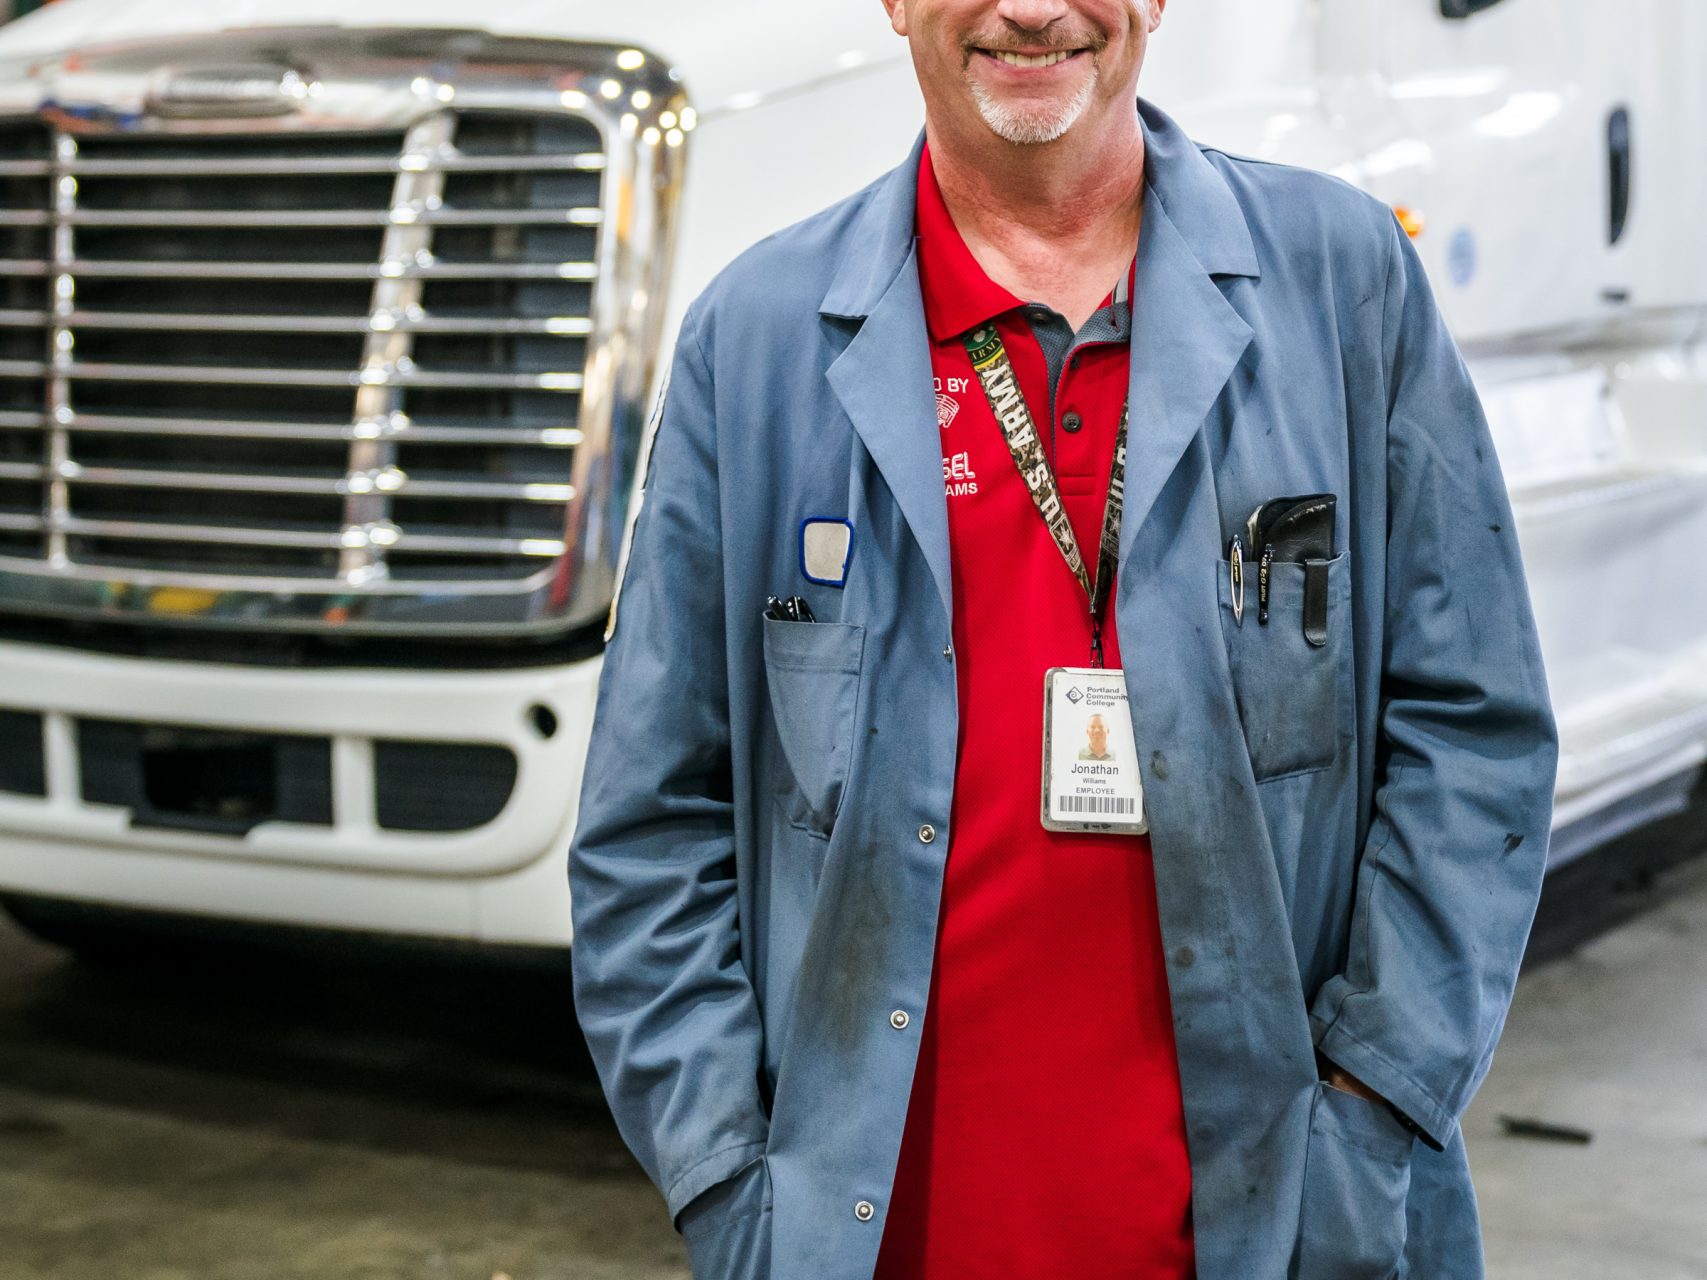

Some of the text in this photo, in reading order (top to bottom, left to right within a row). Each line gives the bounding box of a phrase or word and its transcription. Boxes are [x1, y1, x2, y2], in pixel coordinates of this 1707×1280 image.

[947, 377, 969, 393] BY
[982, 364, 1035, 449] ARMY
[945, 483, 978, 496] AMS
[1071, 763, 1119, 775] Jonathan
